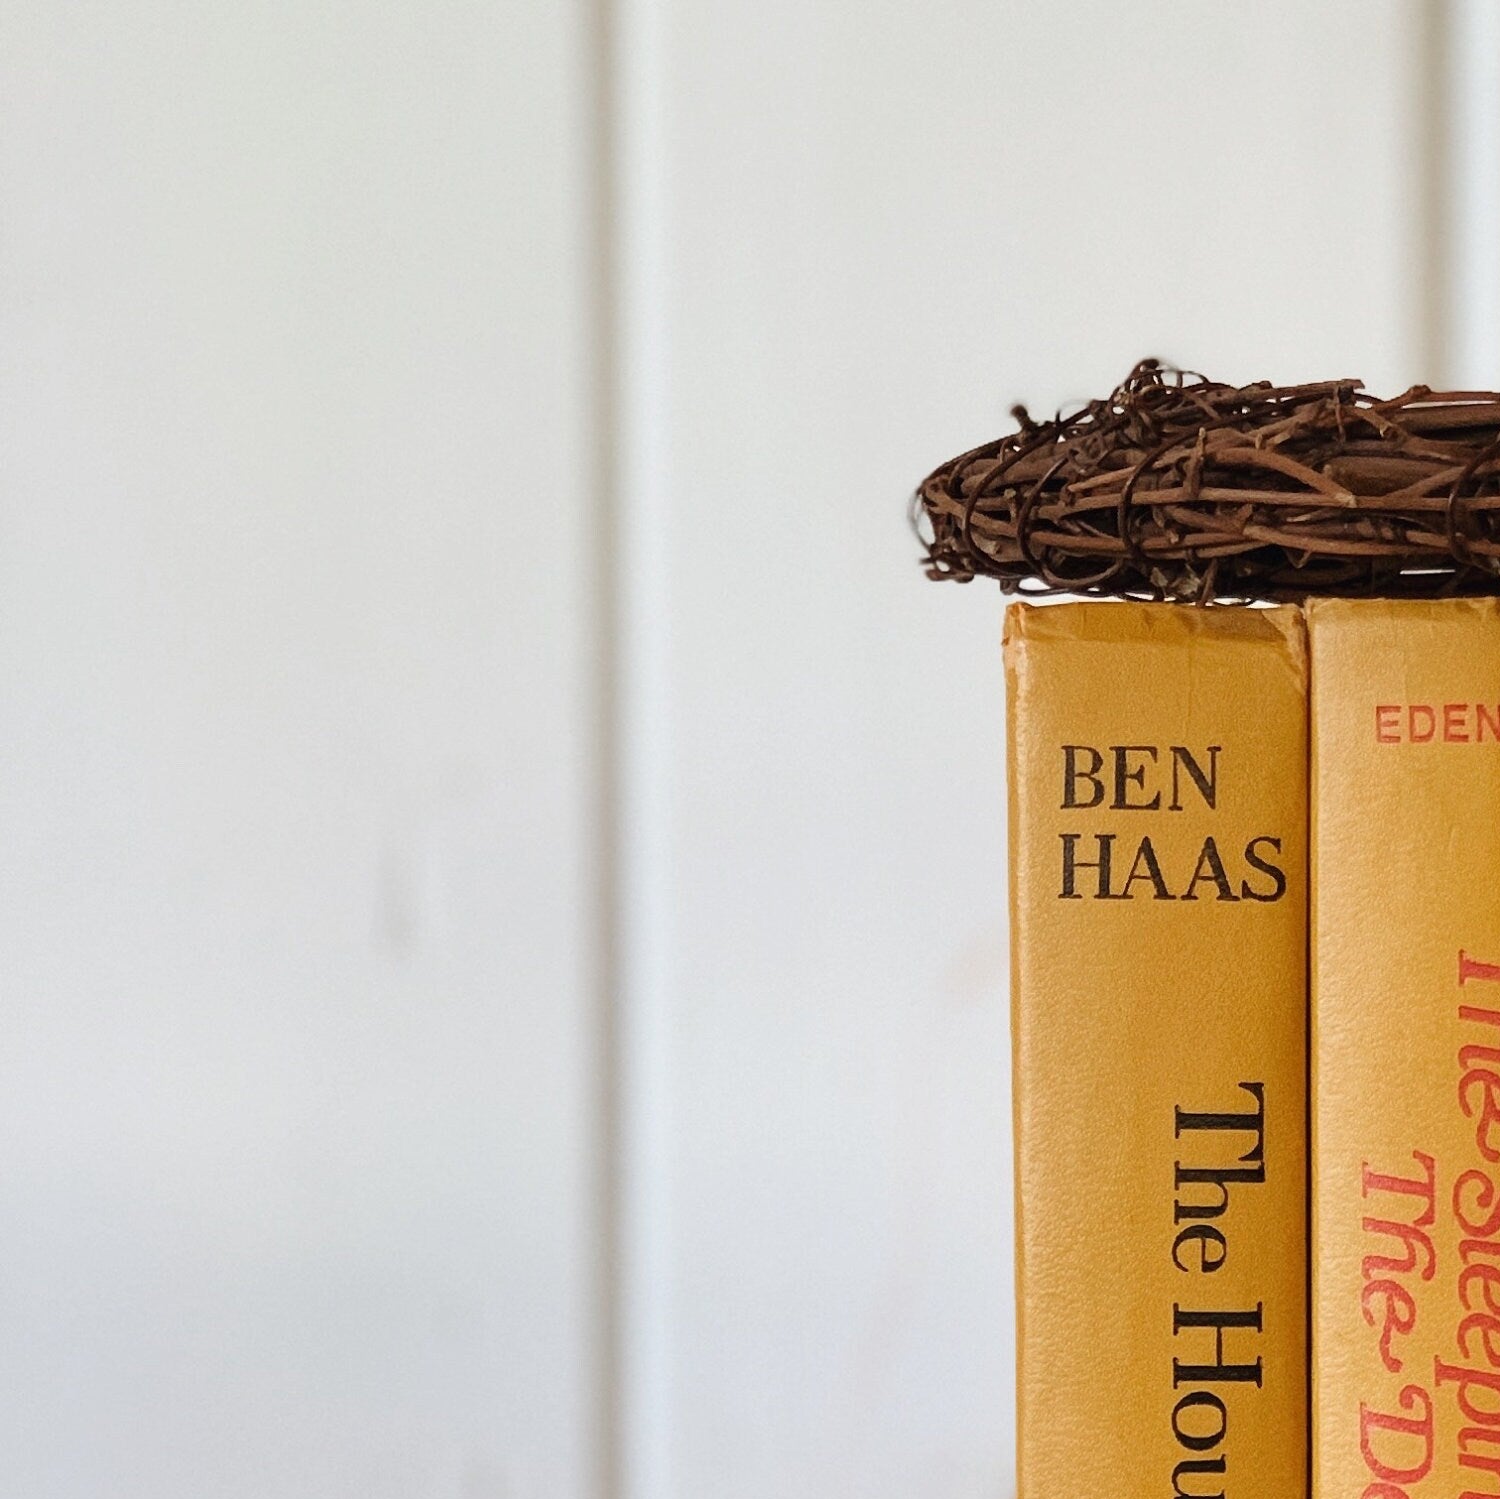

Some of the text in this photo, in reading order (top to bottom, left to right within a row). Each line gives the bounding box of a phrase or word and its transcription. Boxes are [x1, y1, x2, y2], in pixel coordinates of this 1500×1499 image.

[1059, 745, 1222, 812] BEN
[1057, 834, 1288, 902] HAAS
[1172, 1081, 1266, 1274] The
[1361, 1150, 1436, 1374] The
